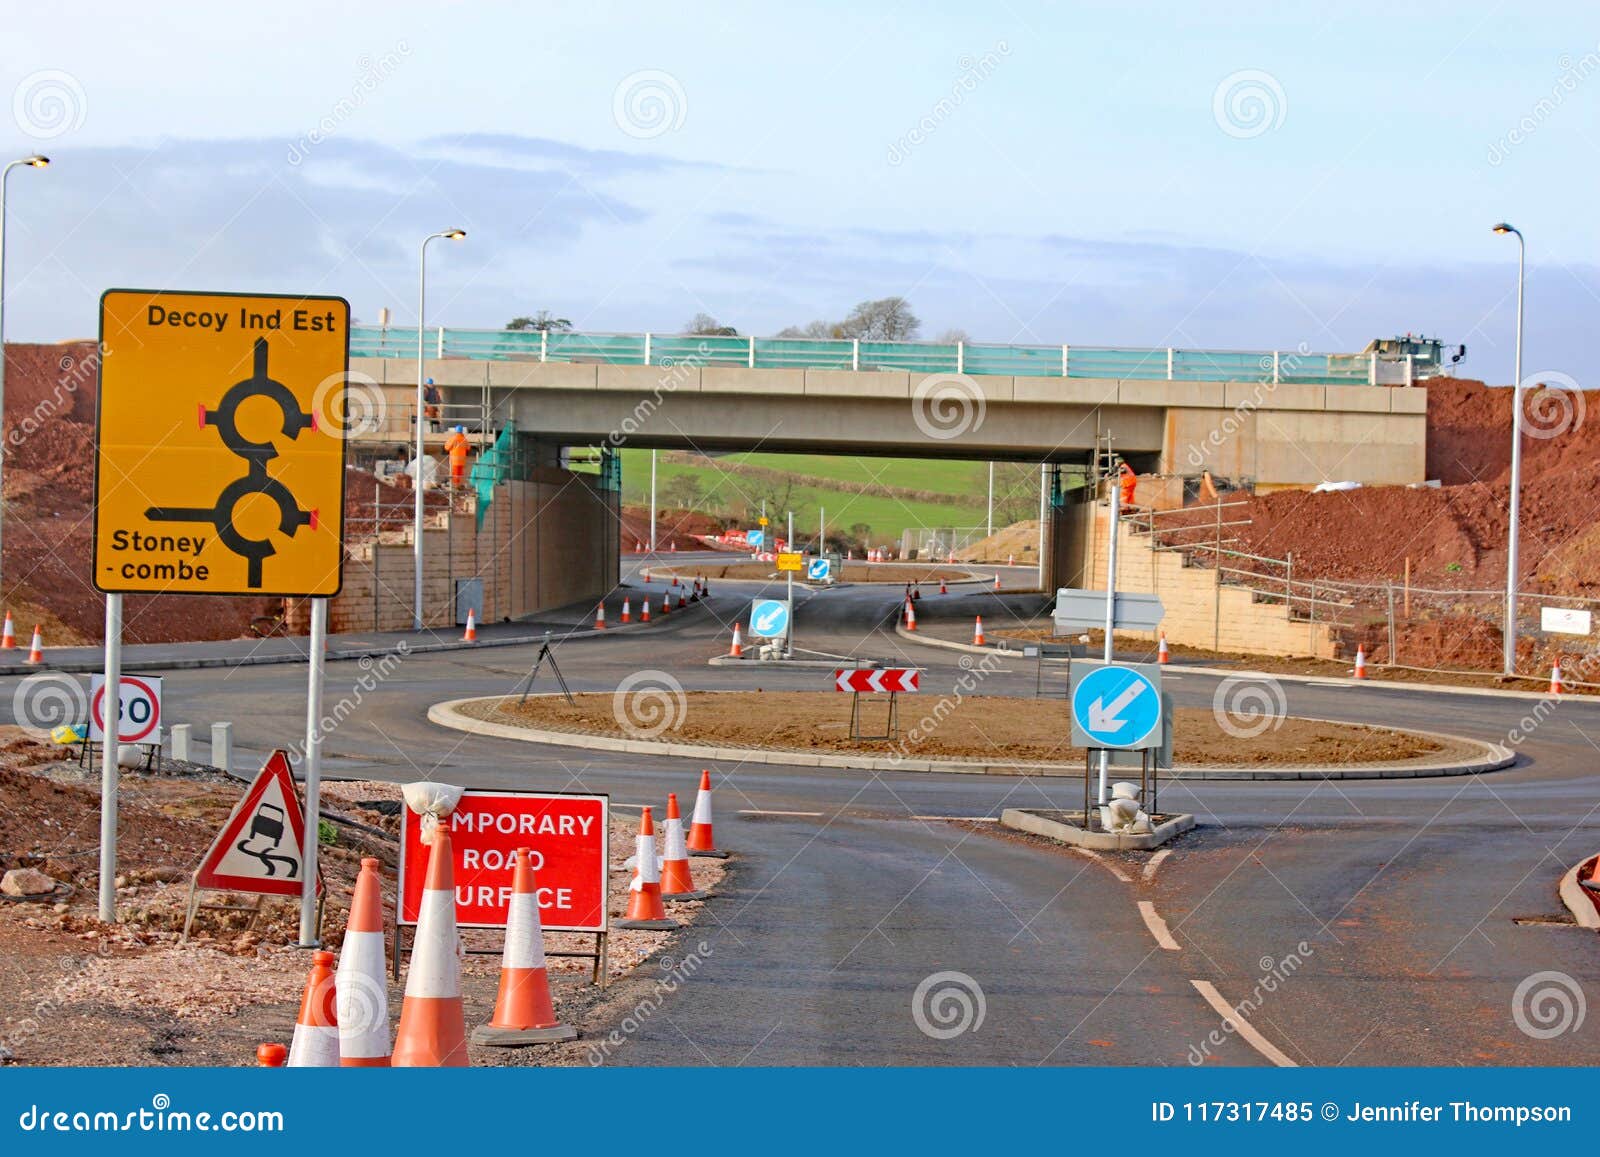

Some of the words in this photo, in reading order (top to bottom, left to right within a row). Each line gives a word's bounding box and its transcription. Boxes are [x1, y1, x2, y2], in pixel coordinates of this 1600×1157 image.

[148, 305, 228, 332] Decoy
[241, 308, 281, 330] Ind
[293, 310, 336, 332] Est
[111, 530, 206, 556] Stoney
[437, 812, 594, 836] MPORARY
[455, 886, 572, 909] URFCE
